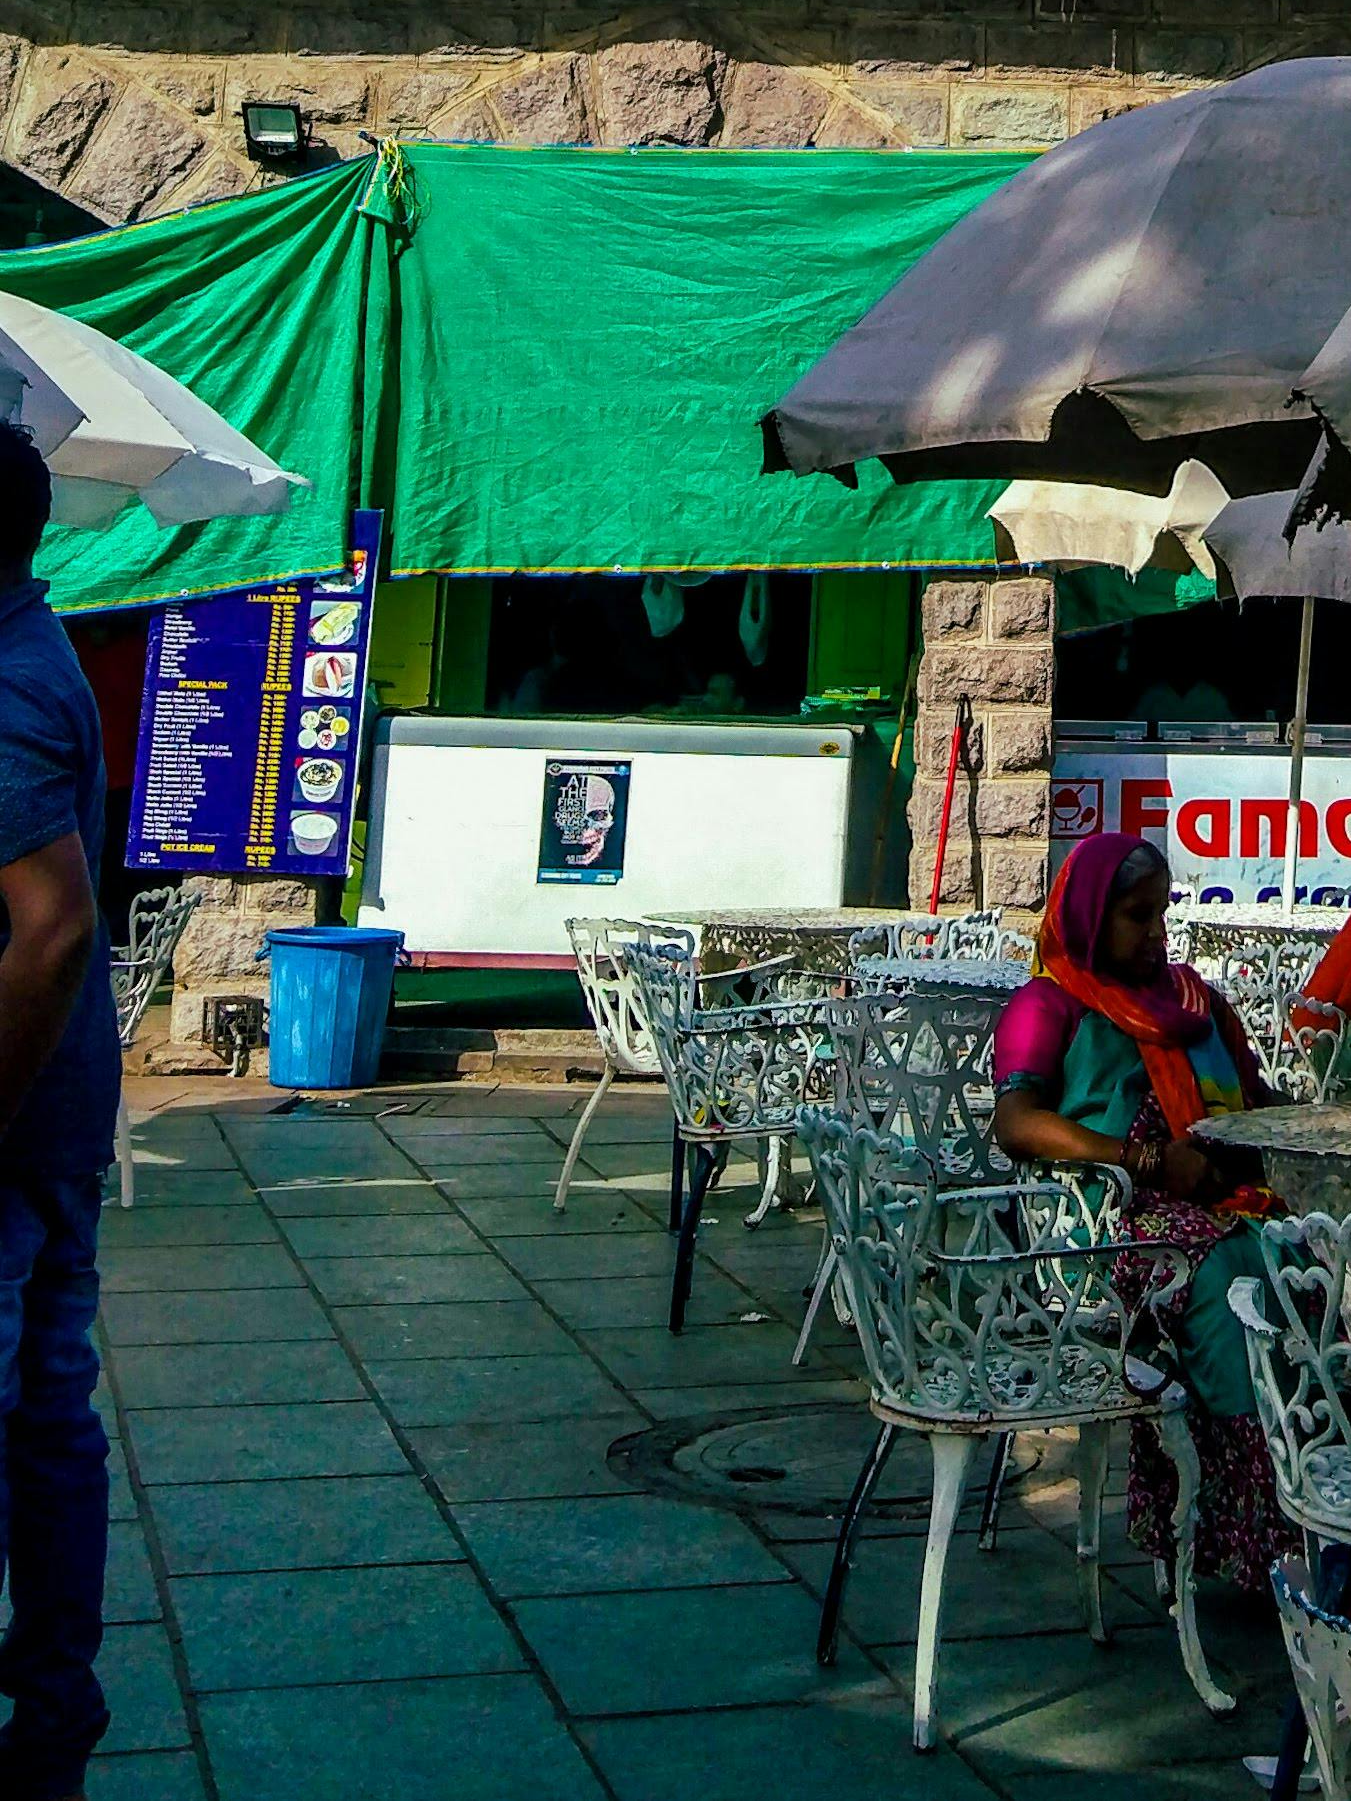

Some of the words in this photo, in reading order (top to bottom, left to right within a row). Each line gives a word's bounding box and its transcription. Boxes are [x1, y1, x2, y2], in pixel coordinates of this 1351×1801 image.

[567, 775, 588, 788] AT
[560, 786, 587, 798] THE
[557, 798, 586, 807] FIRST
